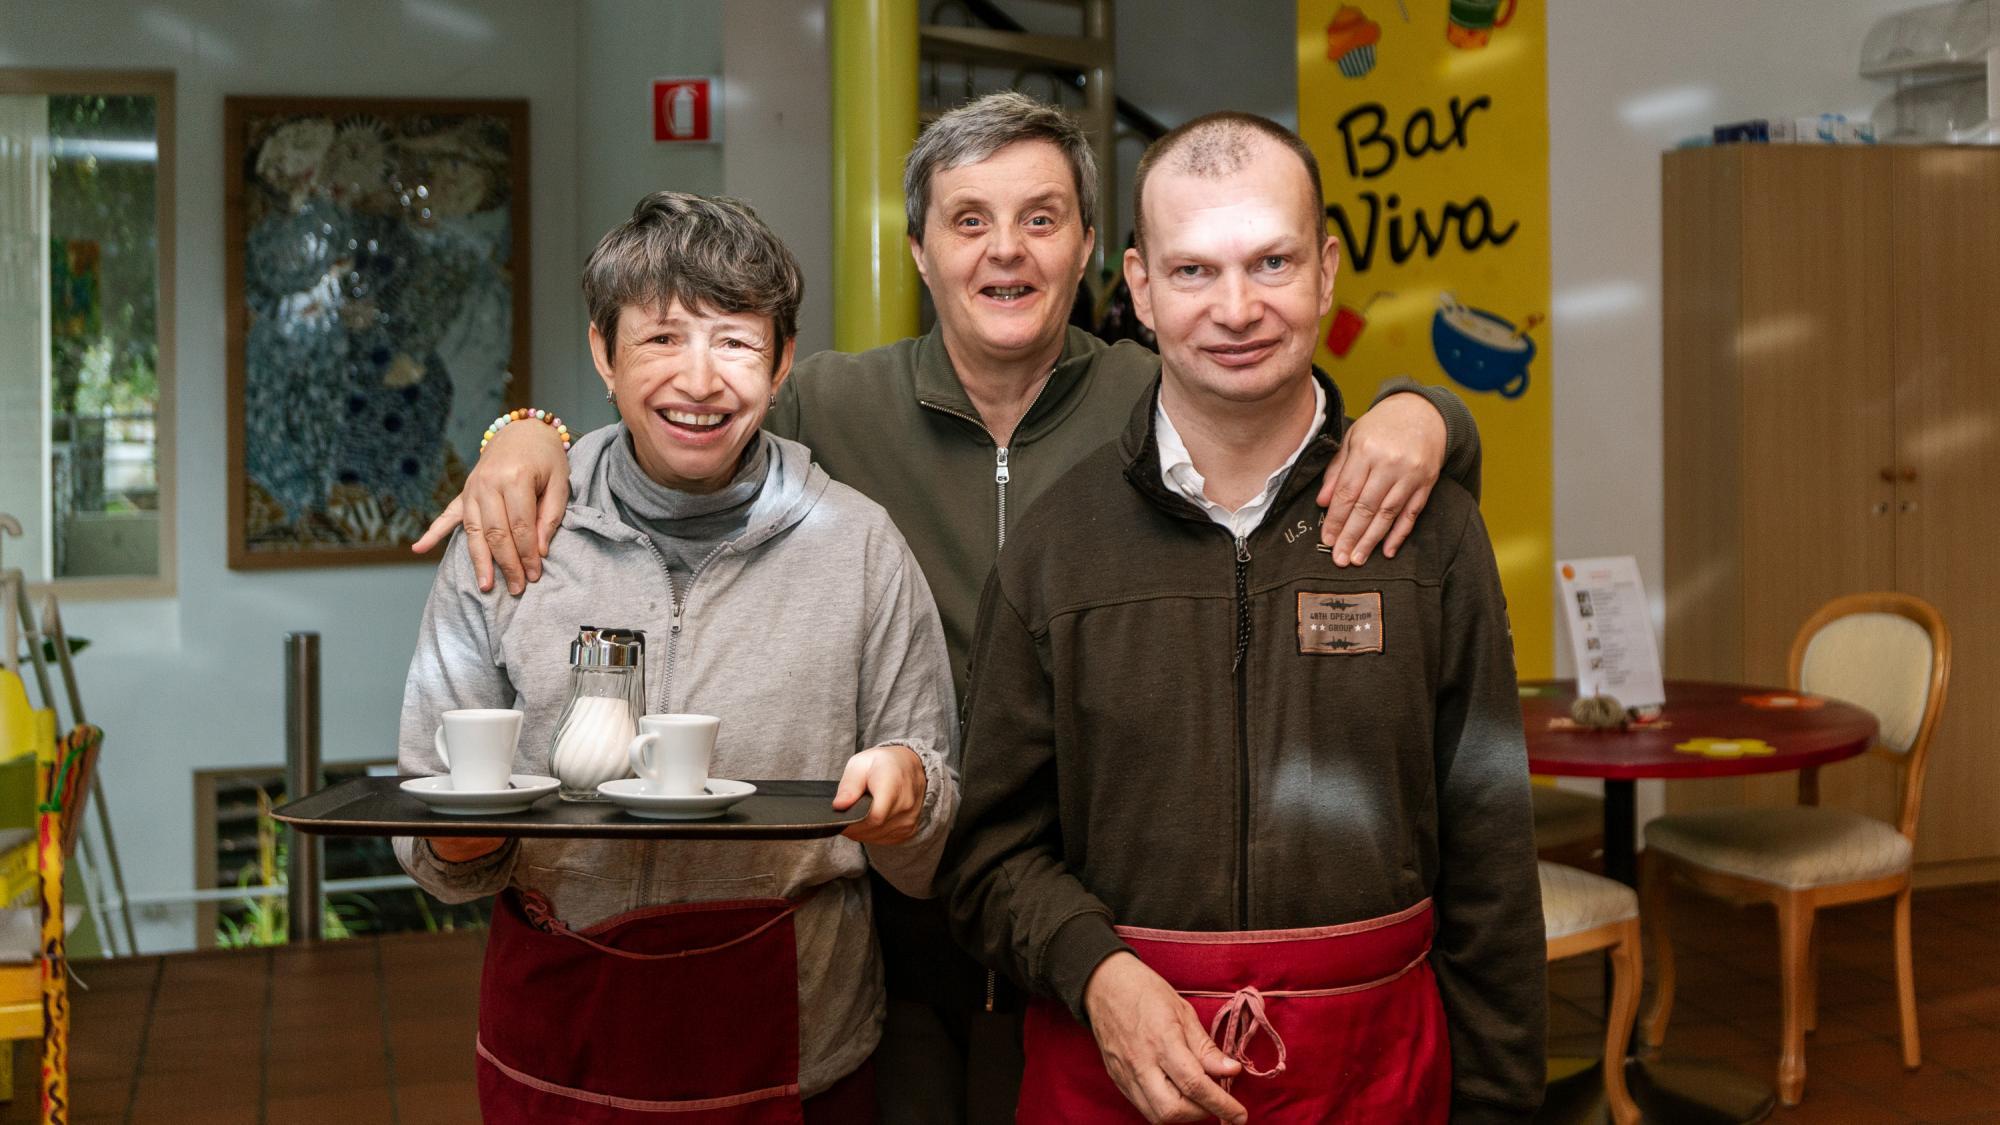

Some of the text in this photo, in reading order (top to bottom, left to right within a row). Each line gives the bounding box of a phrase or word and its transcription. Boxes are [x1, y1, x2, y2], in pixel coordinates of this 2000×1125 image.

[1337, 96, 1491, 179] Bar
[1326, 192, 1519, 274] Viva
[1284, 520, 1313, 544] U.S.
[1328, 624, 1354, 632] GROUP
[1330, 612, 1372, 621] OPERATION
